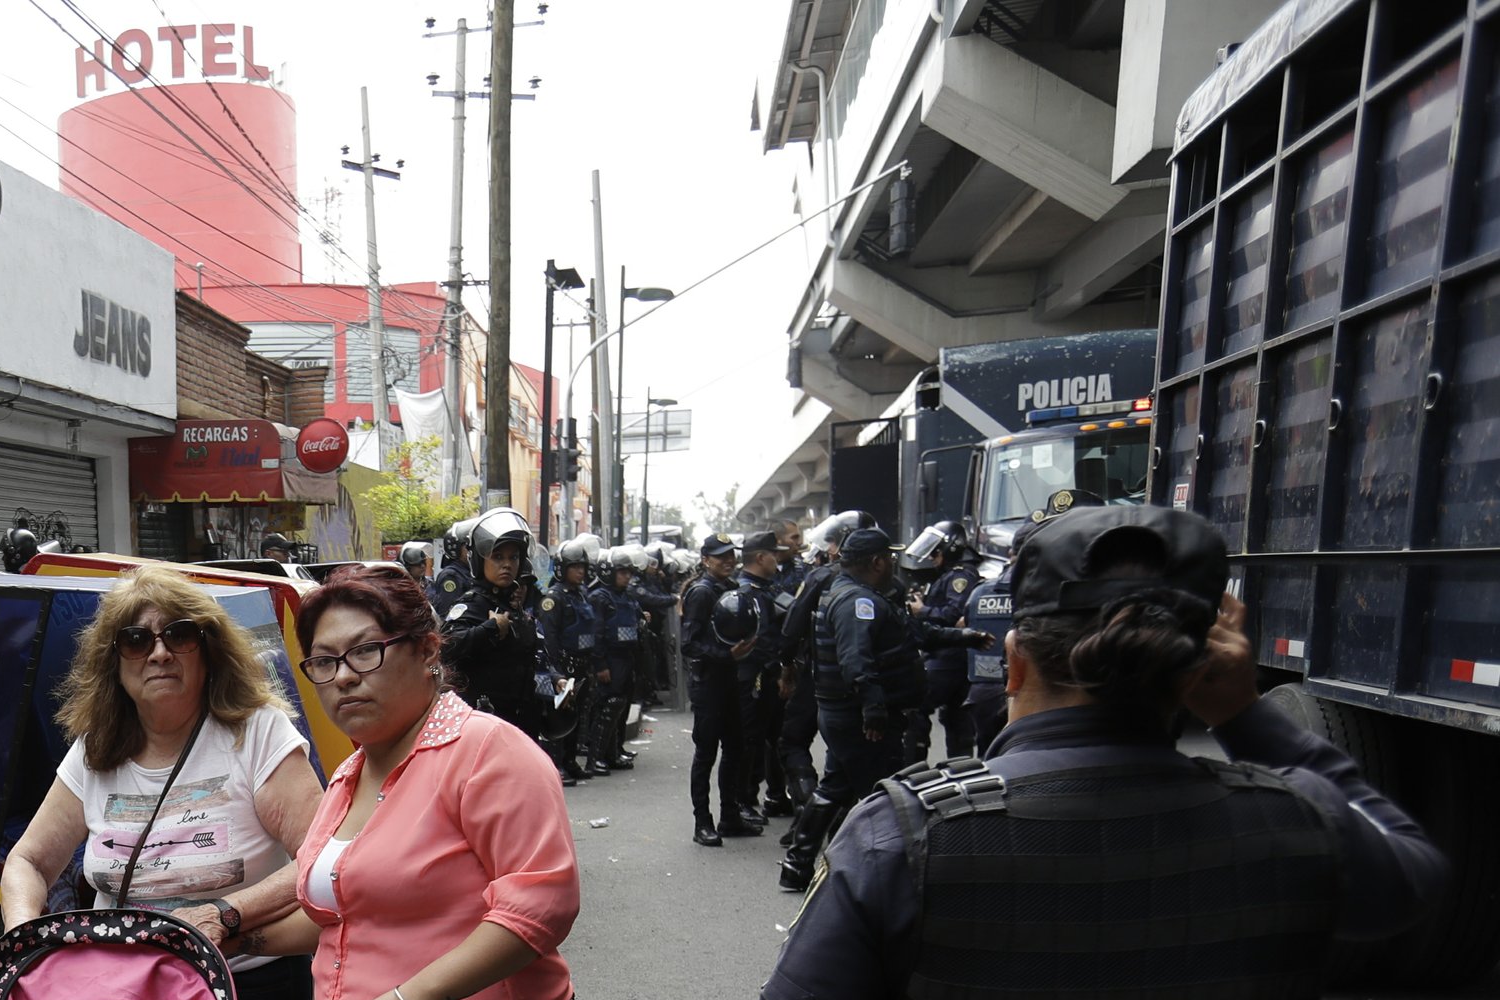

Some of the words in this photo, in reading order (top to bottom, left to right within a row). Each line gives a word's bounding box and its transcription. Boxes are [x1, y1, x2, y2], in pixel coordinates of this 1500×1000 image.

[75, 23, 269, 98] HOTEL
[73, 288, 151, 379] JEANS
[1018, 373, 1113, 411] POLICIA
[183, 426, 248, 443] RECARGAS
